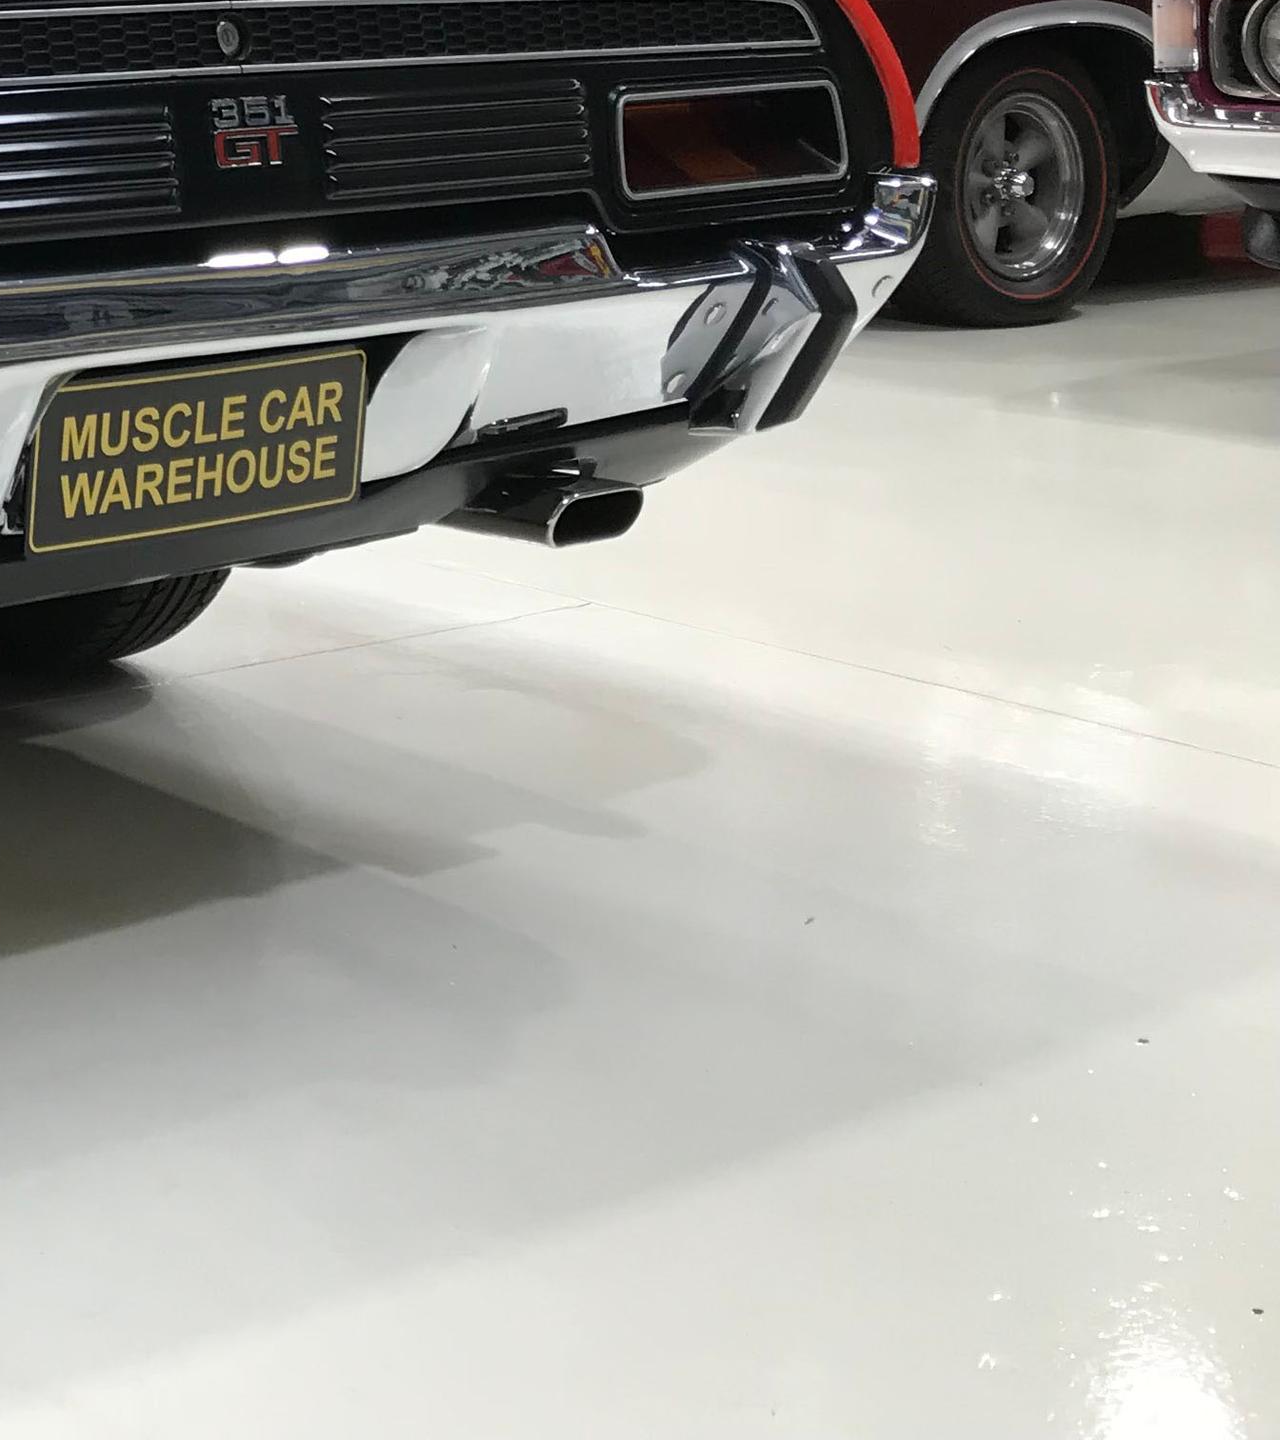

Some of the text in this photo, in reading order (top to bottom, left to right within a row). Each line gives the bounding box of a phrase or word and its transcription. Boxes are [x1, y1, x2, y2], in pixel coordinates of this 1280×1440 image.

[208, 95, 295, 129] 351
[213, 124, 300, 168] GT
[60, 381, 344, 462] MUSCLE CAR
[60, 435, 338, 519] WAREHOUSE
